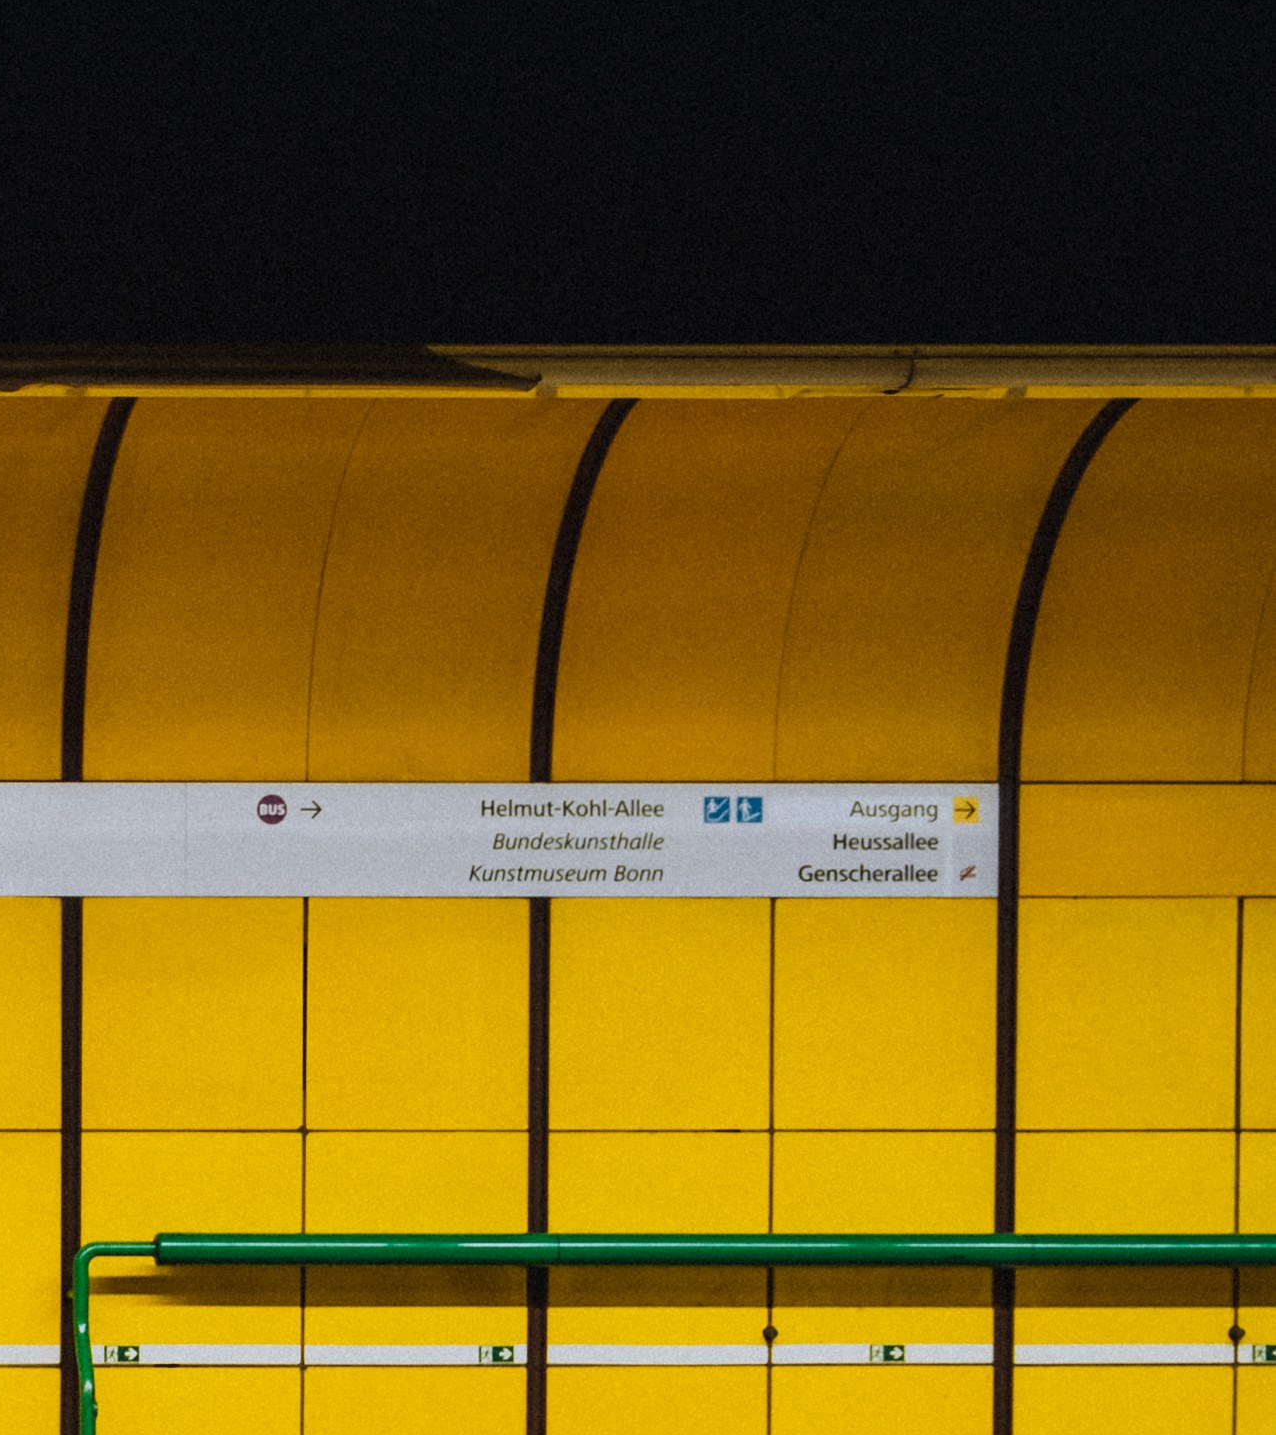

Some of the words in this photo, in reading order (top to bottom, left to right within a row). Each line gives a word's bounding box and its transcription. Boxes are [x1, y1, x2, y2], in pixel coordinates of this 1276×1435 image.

[259, 803, 286, 816] BUS
[481, 800, 665, 818] Helmut-Kohl-Allee
[850, 801, 939, 822] Ausgang
[492, 833, 665, 851] Bundeskunsthalle
[833, 833, 939, 851] Heussallee
[468, 865, 607, 883] Kunstmuseum
[613, 865, 664, 883] Bonn
[798, 864, 939, 883] Genscherallee
